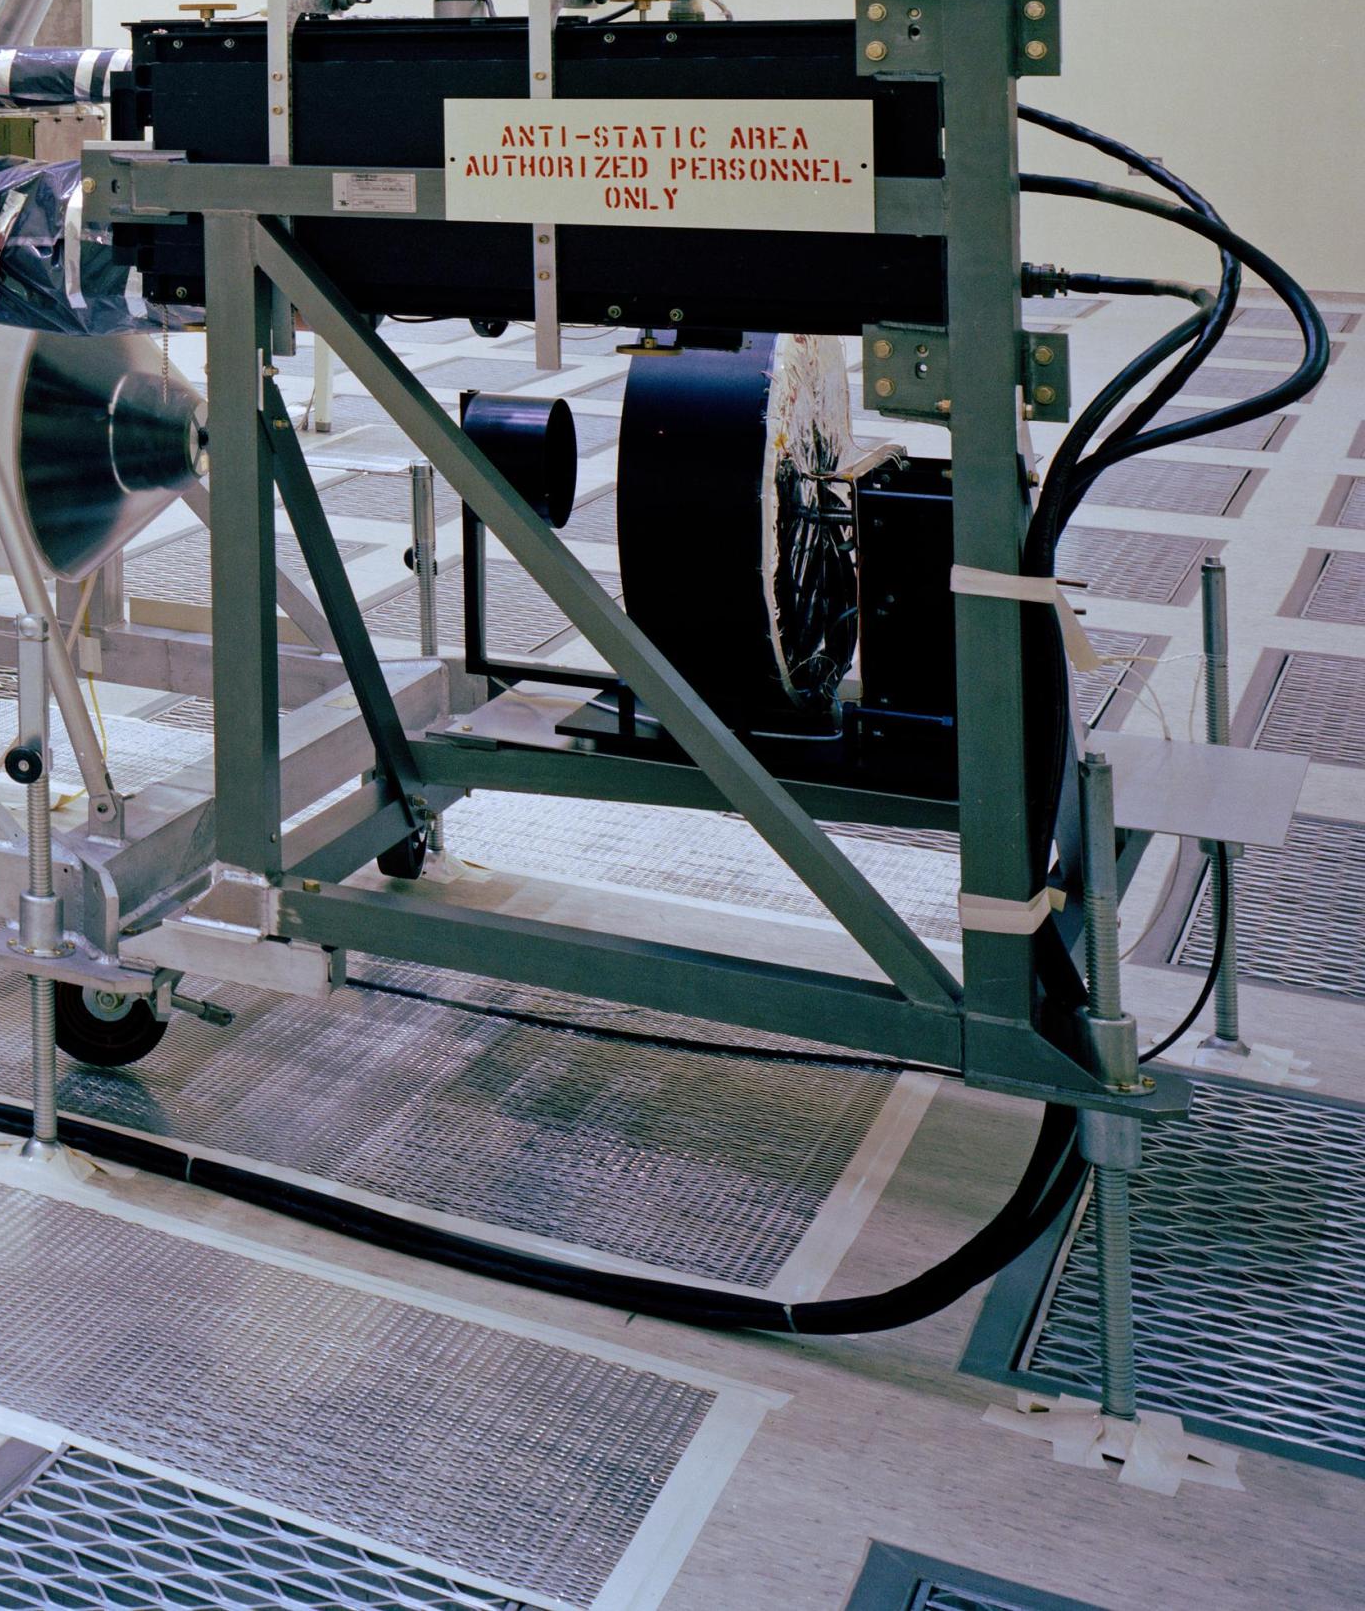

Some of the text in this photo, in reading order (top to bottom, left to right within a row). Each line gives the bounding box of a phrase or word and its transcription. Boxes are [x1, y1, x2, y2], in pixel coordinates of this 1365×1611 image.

[501, 125, 809, 150] ANTI-STATIC AREA
[465, 155, 852, 184] AUTHORIZED PERSONNEL
[604, 186, 679, 210] ONLY
